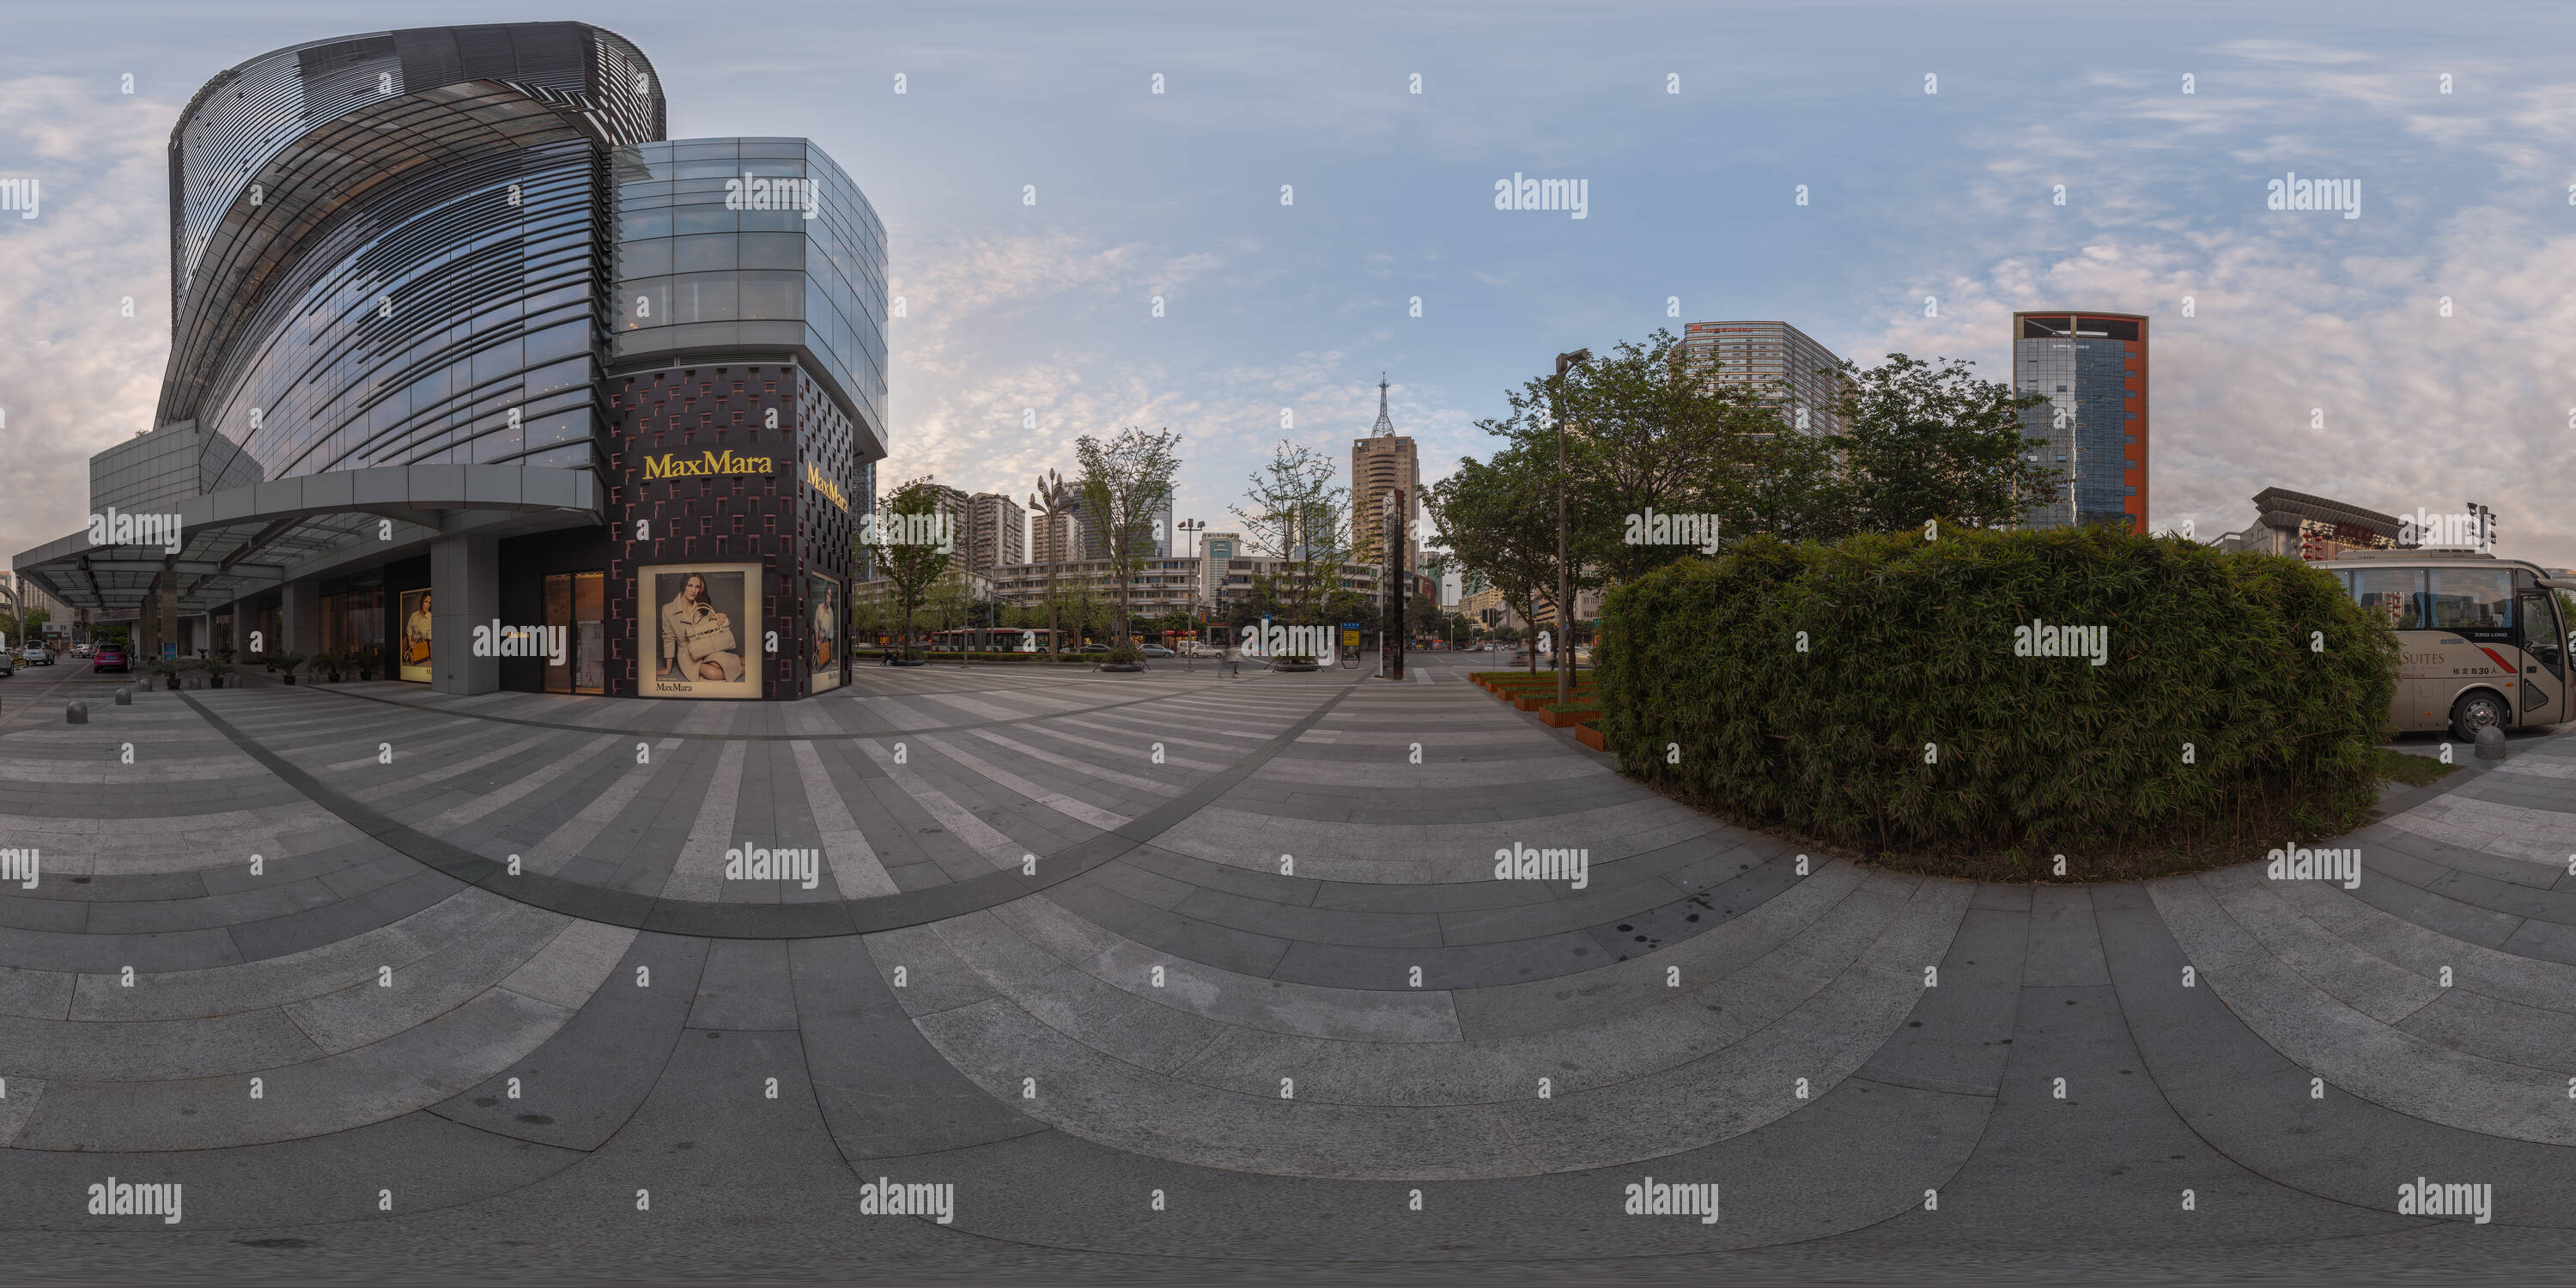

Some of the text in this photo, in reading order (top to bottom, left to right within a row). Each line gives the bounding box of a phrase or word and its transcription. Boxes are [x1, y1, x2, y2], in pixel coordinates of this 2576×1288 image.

[642, 449, 773, 480] MaxMara
[806, 460, 848, 513] MaxMara
[656, 683, 692, 691] MaxMara
